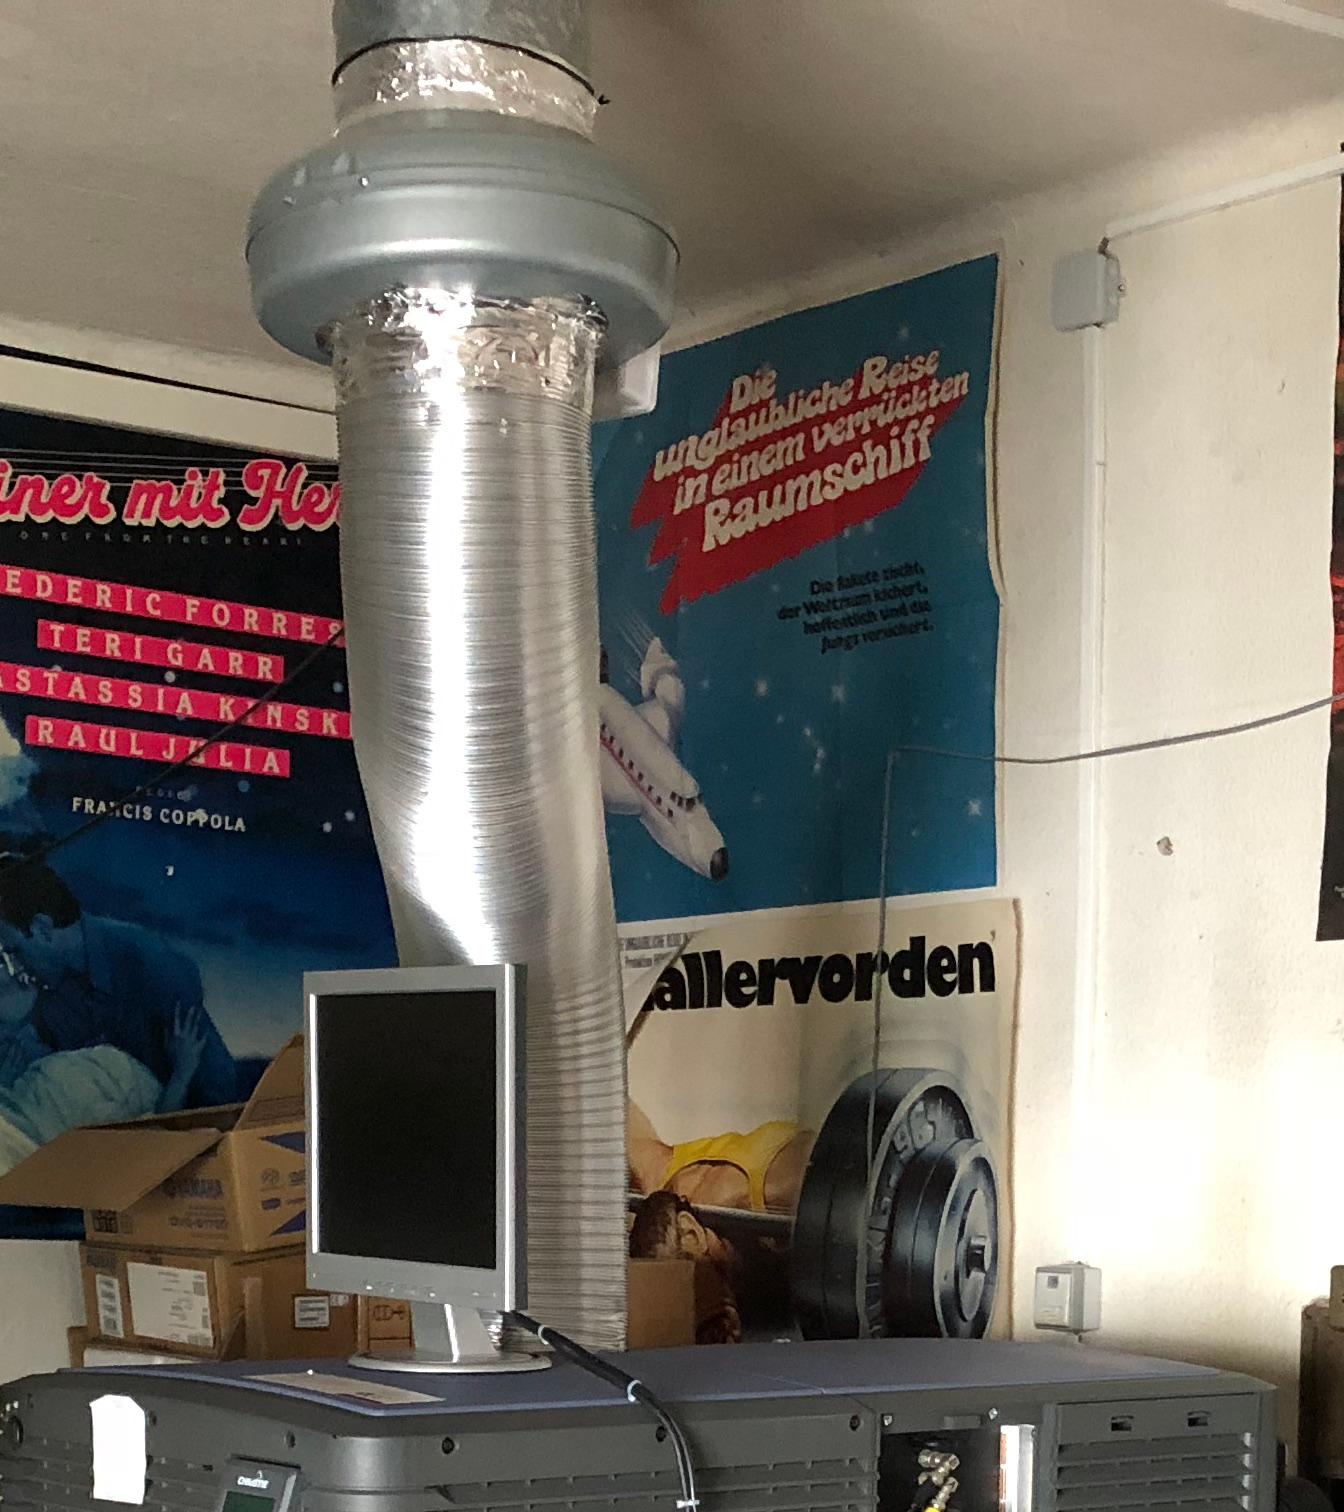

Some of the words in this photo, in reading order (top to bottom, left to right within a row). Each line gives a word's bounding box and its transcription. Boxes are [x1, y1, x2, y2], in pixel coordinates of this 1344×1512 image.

[652, 376, 855, 481] unglaubliche
[857, 349, 941, 401] Reise
[729, 368, 777, 414] Die
[672, 472, 707, 516] in
[712, 430, 805, 496] einem
[810, 371, 971, 455] verrückten
[122, 466, 229, 529] mit
[701, 415, 936, 553] Raumschiff
[84, 531, 153, 544] FROM
[48, 623, 144, 661] TERI
[166, 642, 275, 682] GARR
[37, 717, 143, 756] RAUL
[161, 735, 281, 777] JULIA
[71, 796, 153, 822] FRANCIS
[158, 807, 247, 833] COPPOLA
[638, 935, 997, 1014] allervorden
